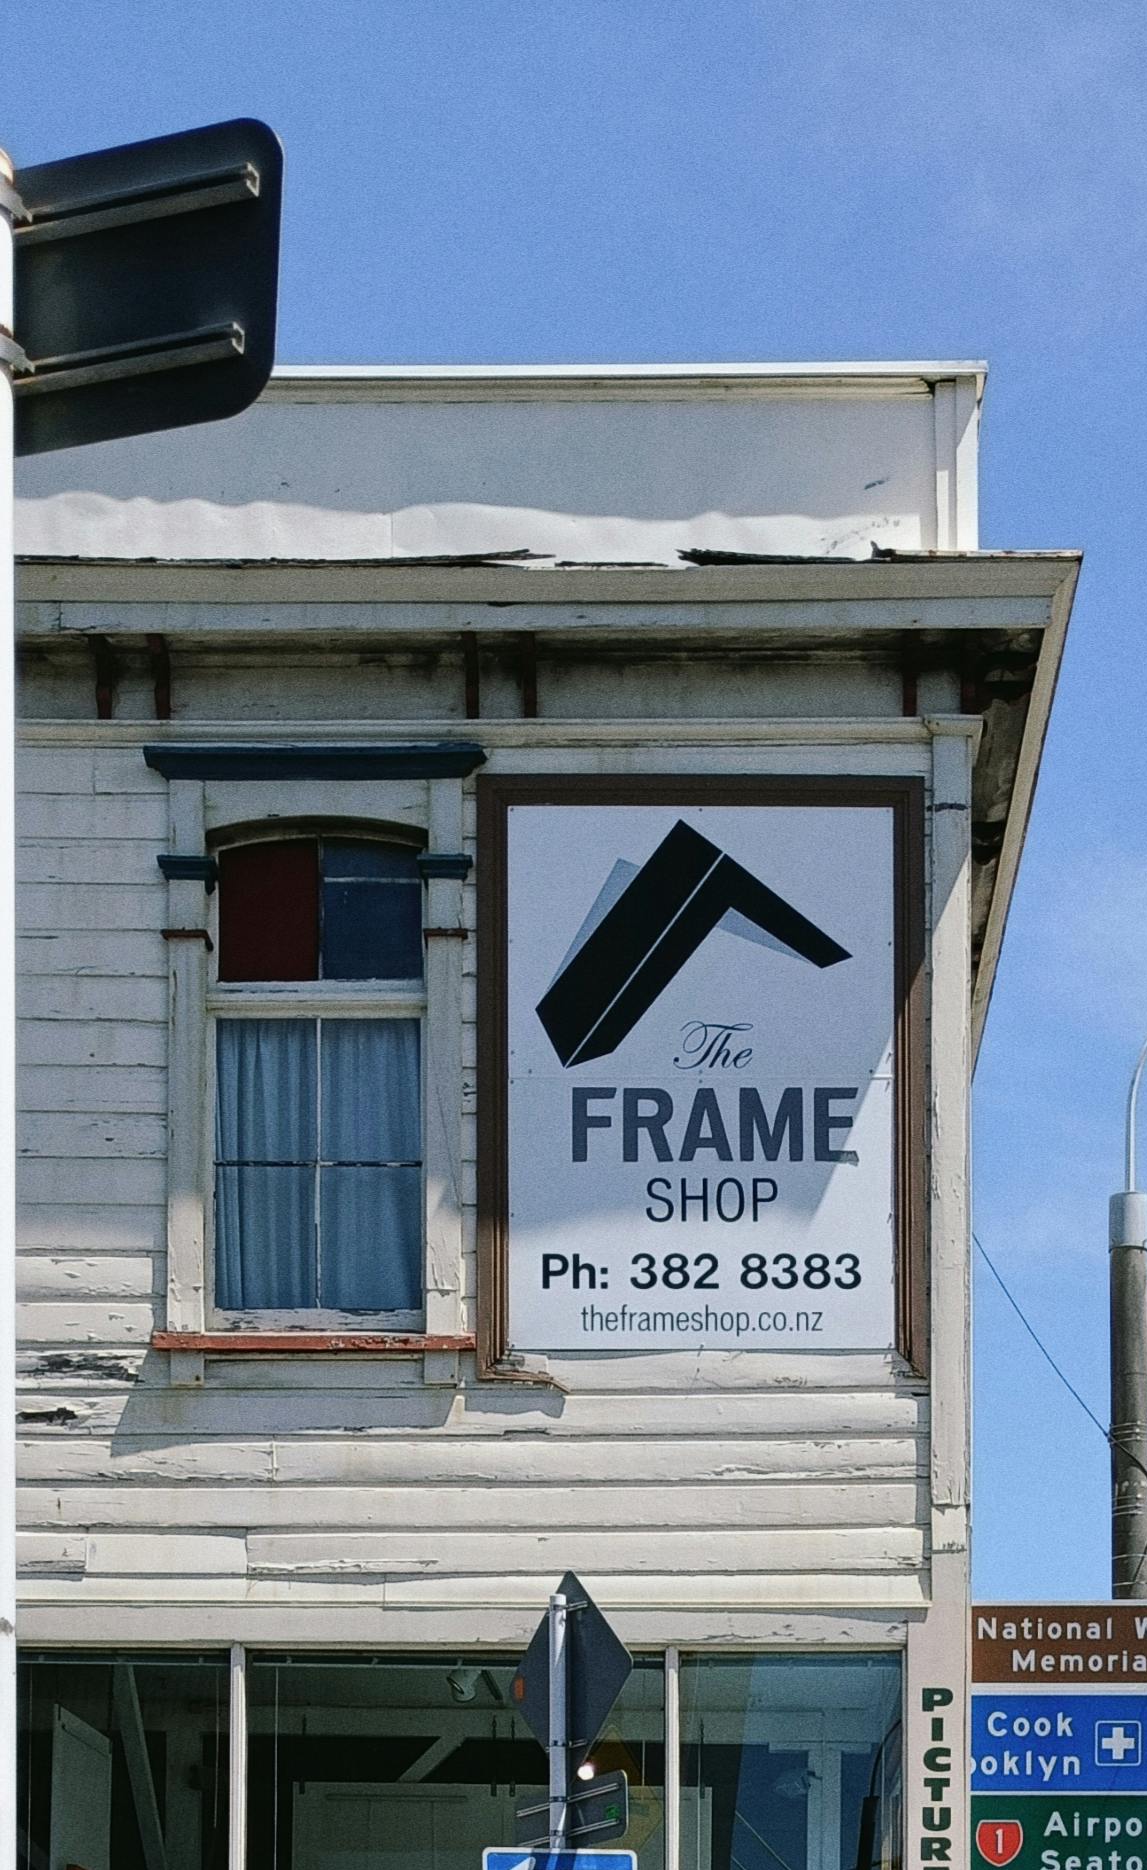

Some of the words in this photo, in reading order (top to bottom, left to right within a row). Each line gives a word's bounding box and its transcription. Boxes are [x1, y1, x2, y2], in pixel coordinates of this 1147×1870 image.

[672, 1020, 754, 1070] The
[571, 1087, 859, 1167] FRAME
[645, 1178, 779, 1223] SHOP
[541, 1253, 609, 1290] Ph:
[629, 1253, 720, 1290] 382
[739, 1253, 862, 1290] 8383
[581, 1304, 824, 1336] theframeshop.co.nz
[977, 1616, 1113, 1640] National
[987, 1711, 1073, 1737] Cook
[995, 1828, 1004, 1856] 1
